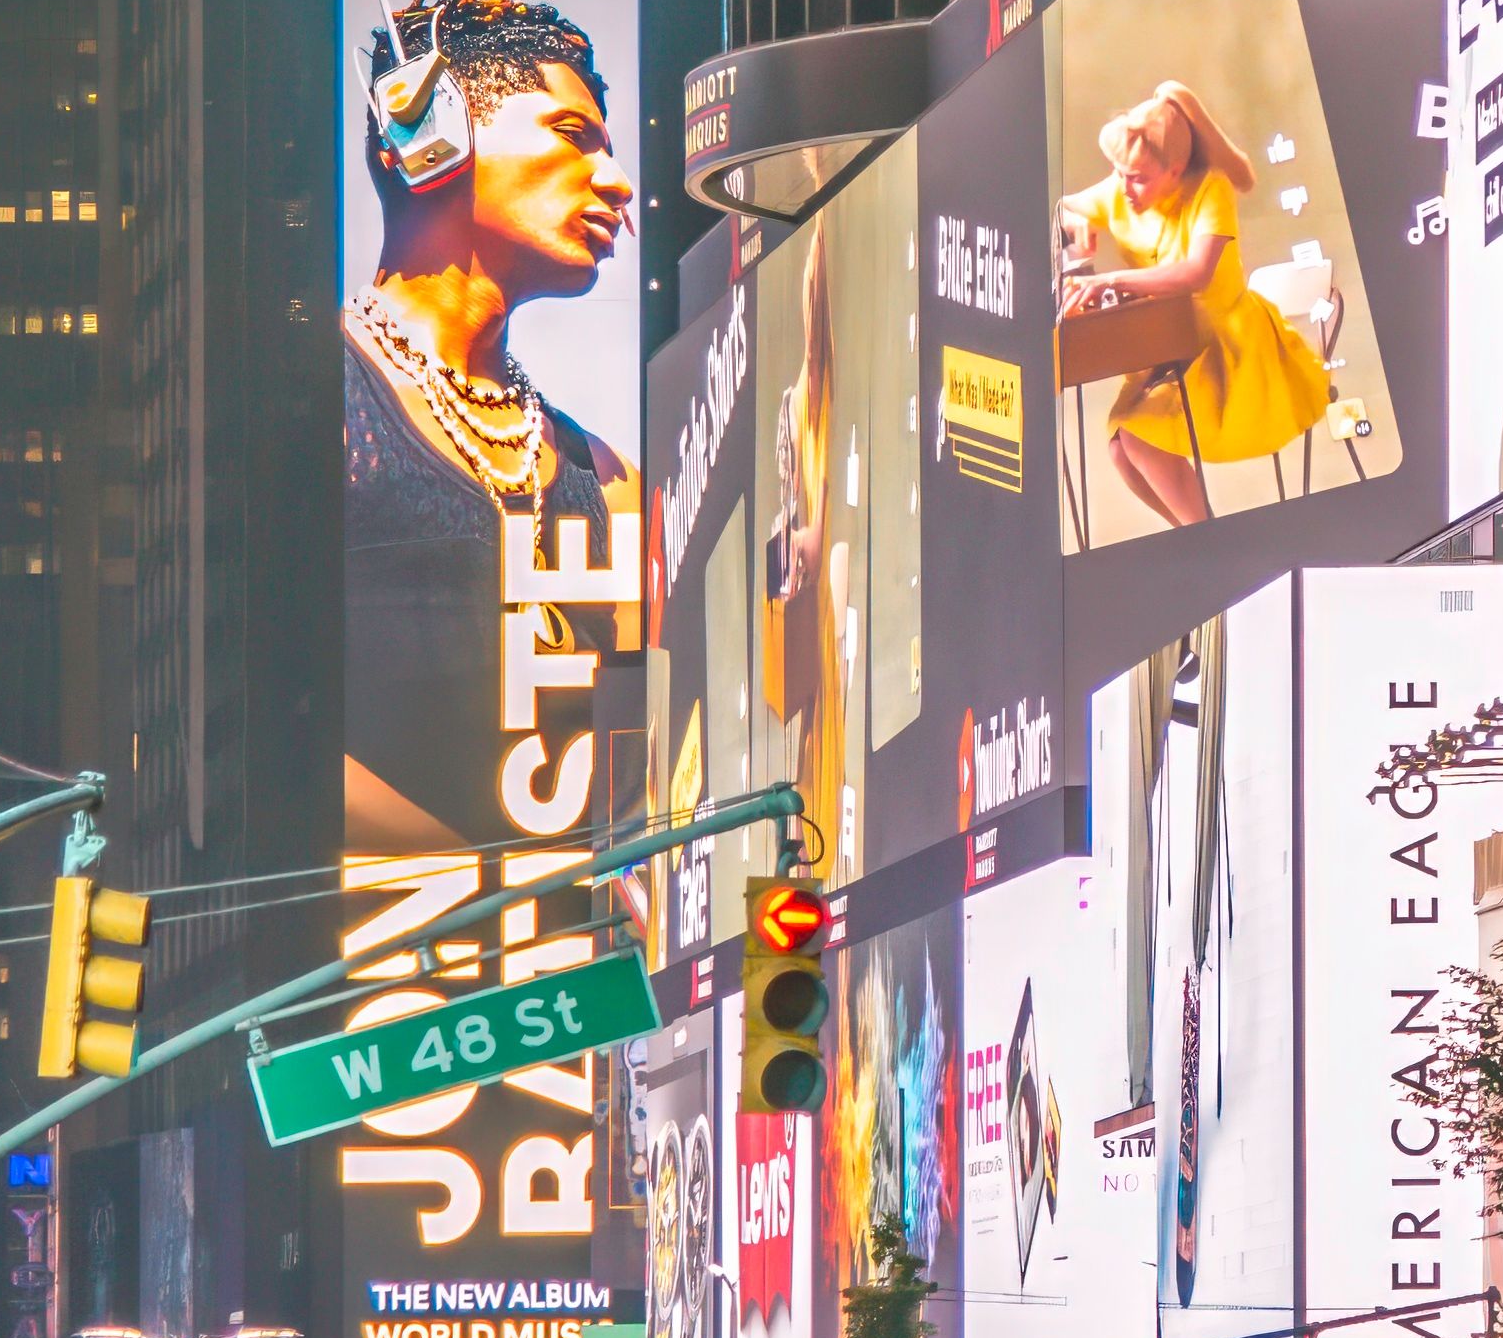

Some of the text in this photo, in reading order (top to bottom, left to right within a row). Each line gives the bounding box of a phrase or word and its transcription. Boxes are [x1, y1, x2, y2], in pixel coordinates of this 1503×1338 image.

[937, 216, 1013, 319] Billie Eilish
[663, 281, 748, 598] YouTube Shorts
[974, 695, 1051, 815] YouTube Shorts
[1390, 679, 1439, 926] EAGLE
[332, 990, 583, 1100] W 48 St
[968, 1043, 1002, 1148] FREE
[372, 1282, 609, 1310] THE NEW ALBUM
